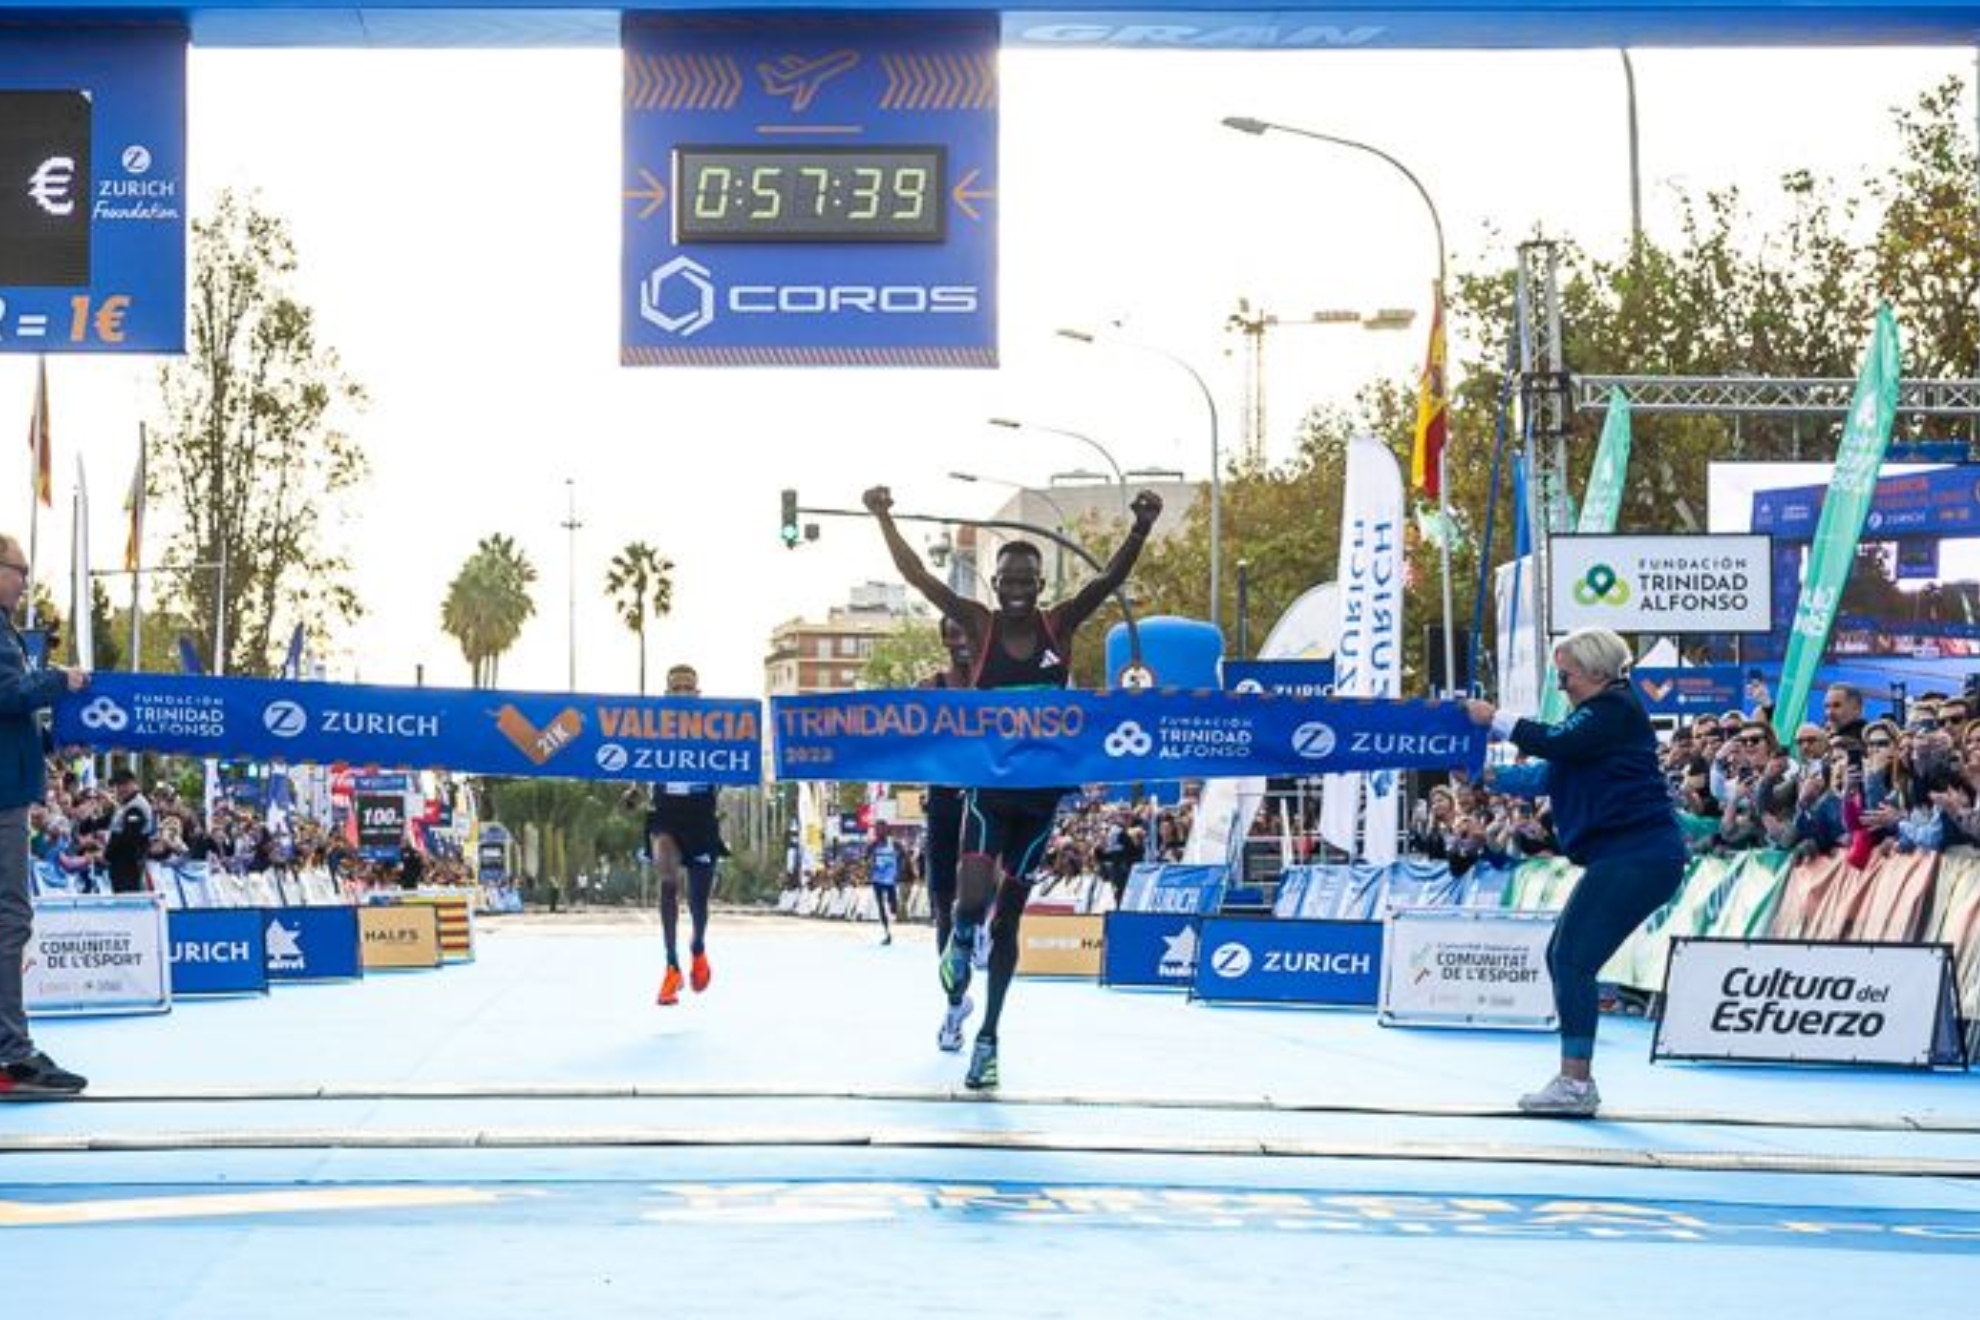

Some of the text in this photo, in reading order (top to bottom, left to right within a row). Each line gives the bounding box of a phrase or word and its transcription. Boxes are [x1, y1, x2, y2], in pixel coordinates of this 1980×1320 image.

[1022, 24, 1390, 45] GRAN
[100, 180, 176, 196] ZURICH
[695, 167, 926, 219] 0:57:39
[92, 200, 179, 219] Foundation
[729, 286, 978, 313] COROS
[1638, 556, 1747, 570] FUNDACIÓN
[1638, 573, 1749, 591] TRINIDAD
[1640, 593, 1749, 611] ALFONSO
[134, 707, 225, 723] TRINIDAD
[322, 710, 439, 737] ZURICH
[599, 706, 757, 740] VALENCIA
[785, 704, 1084, 738] TRINIDAD ALFONSO
[134, 723, 225, 737] ALFONSO
[537, 724, 570, 756] 21K
[1160, 728, 1252, 745] TRINIDAD
[1160, 744, 1250, 760] ALFONSO
[1351, 731, 1470, 755] ZURICH
[634, 748, 751, 771] ZURICH
[40, 939, 130, 955] COMUNITAT
[169, 941, 249, 963] URICH
[48, 953, 142, 969] DE L'ESPORT
[1262, 951, 1370, 975] ZURICH
[1437, 952, 1528, 967] COMUNITAT
[1443, 967, 1540, 984] DE L'ESPORT
[1722, 967, 1890, 1003] Cultura del
[1710, 1001, 1886, 1038] Esfuerzo
